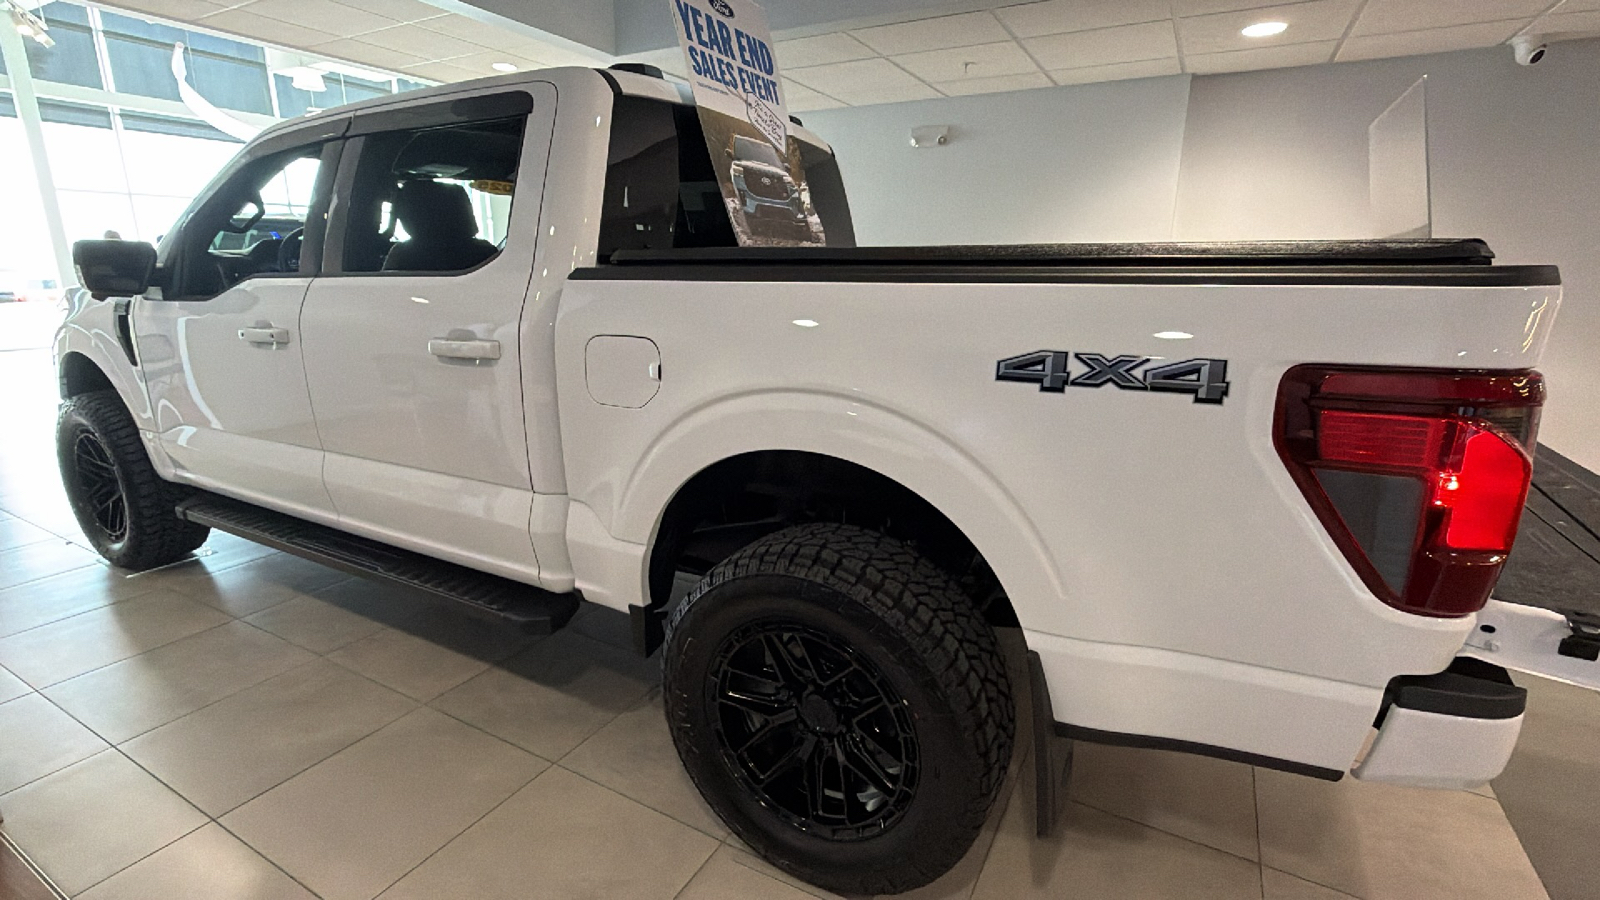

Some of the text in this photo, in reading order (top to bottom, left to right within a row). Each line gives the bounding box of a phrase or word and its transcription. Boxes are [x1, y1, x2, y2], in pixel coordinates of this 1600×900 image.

[675, 0, 774, 76] YEAR END
[688, 45, 780, 105] SALES EVENT
